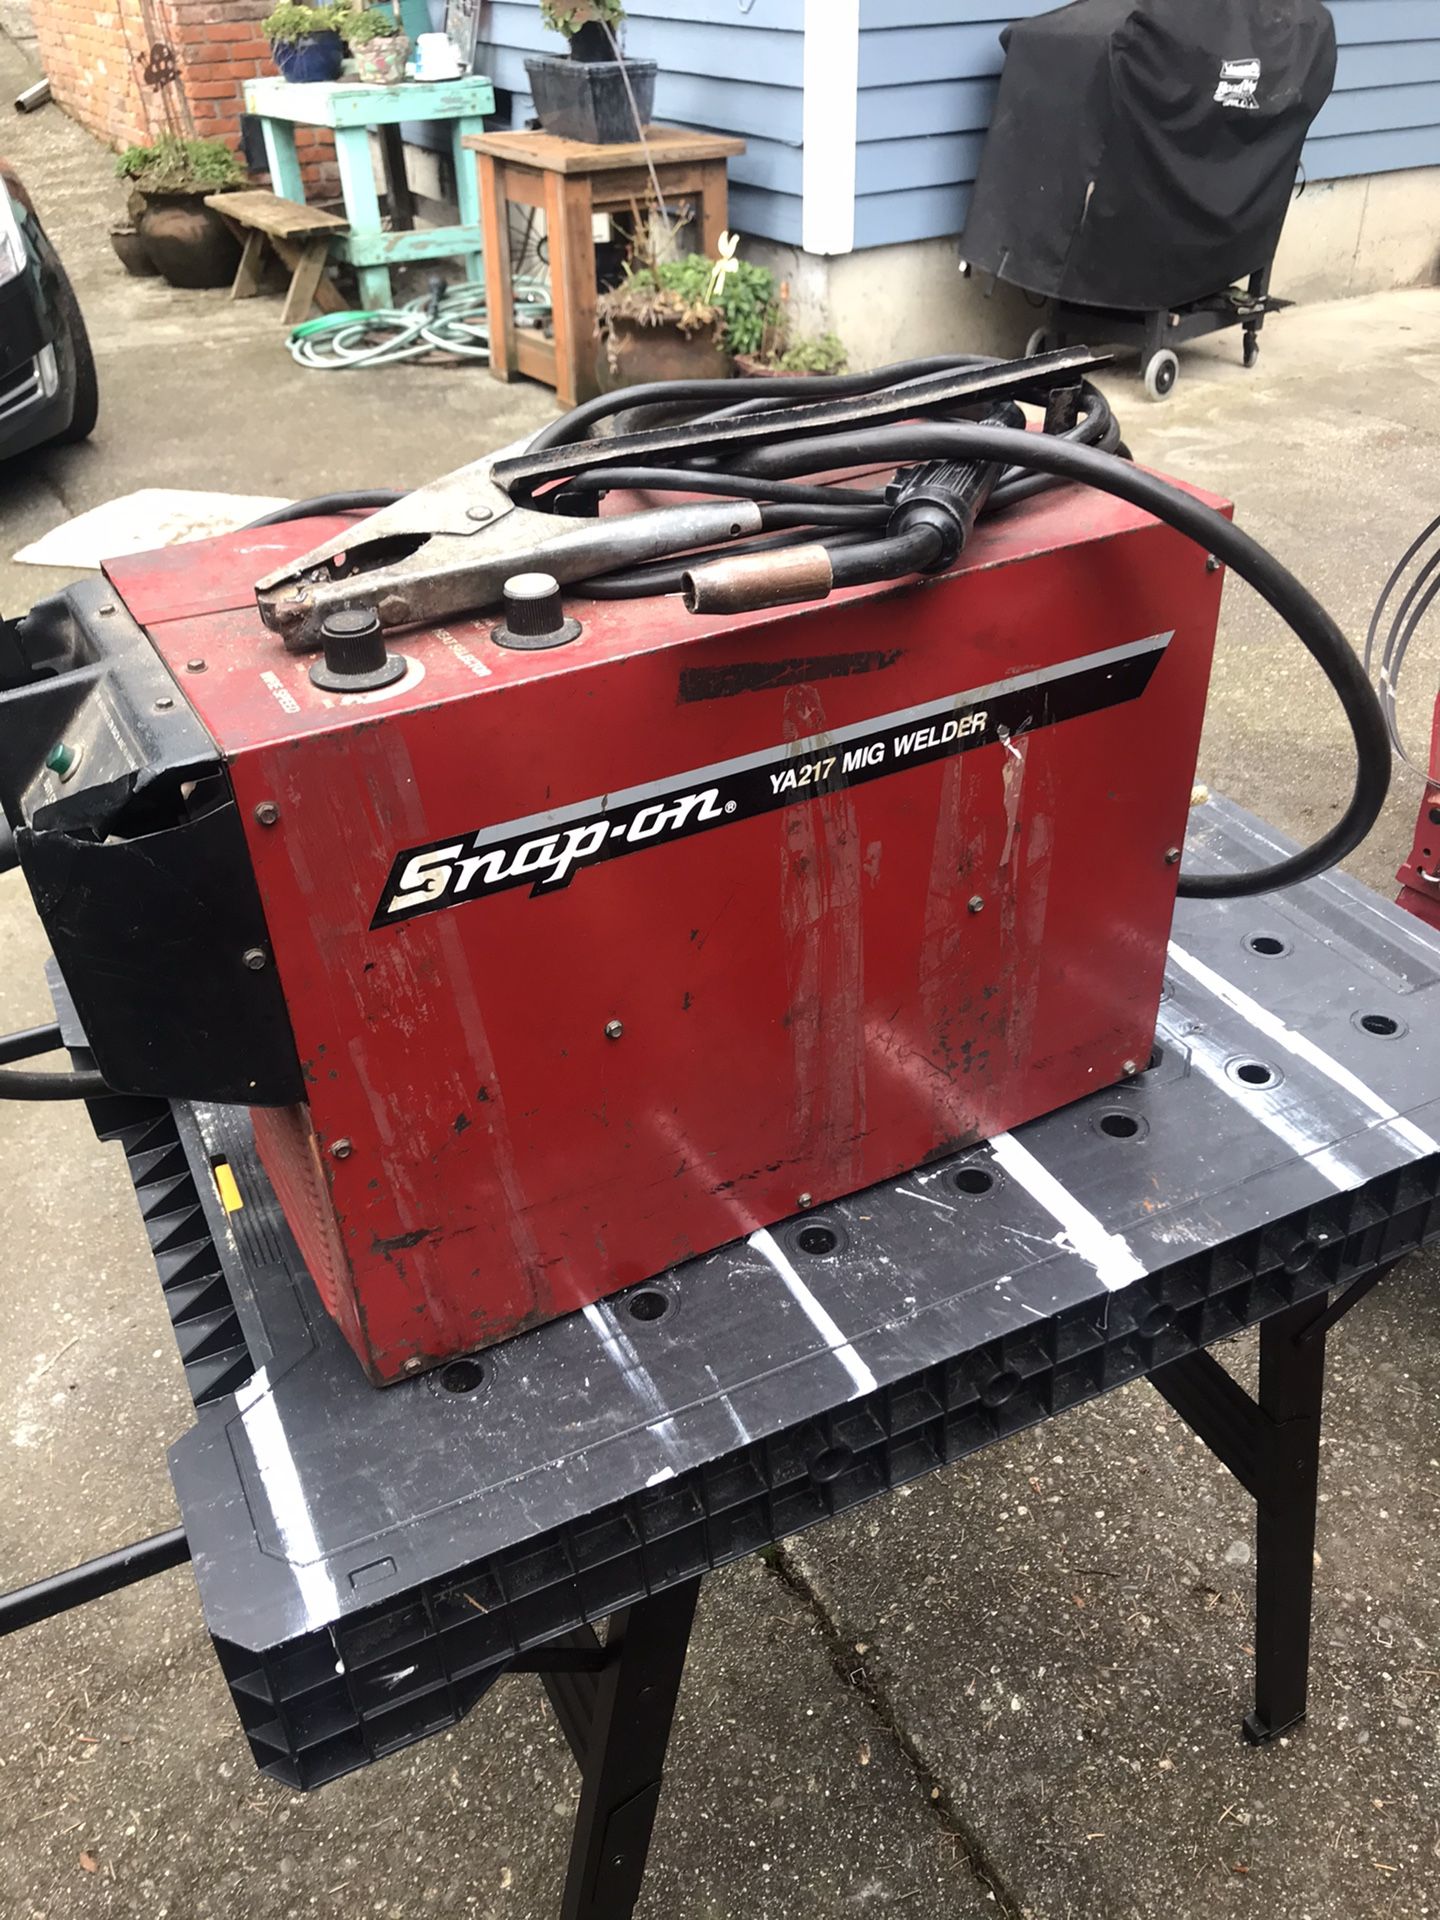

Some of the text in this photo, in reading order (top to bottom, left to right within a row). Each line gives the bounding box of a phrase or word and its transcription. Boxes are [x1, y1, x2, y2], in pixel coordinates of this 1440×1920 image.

[272, 689, 301, 713] SPEED
[770, 757, 836, 794] YA217
[842, 742, 885, 774] MIG
[893, 711, 988, 757] WELDER
